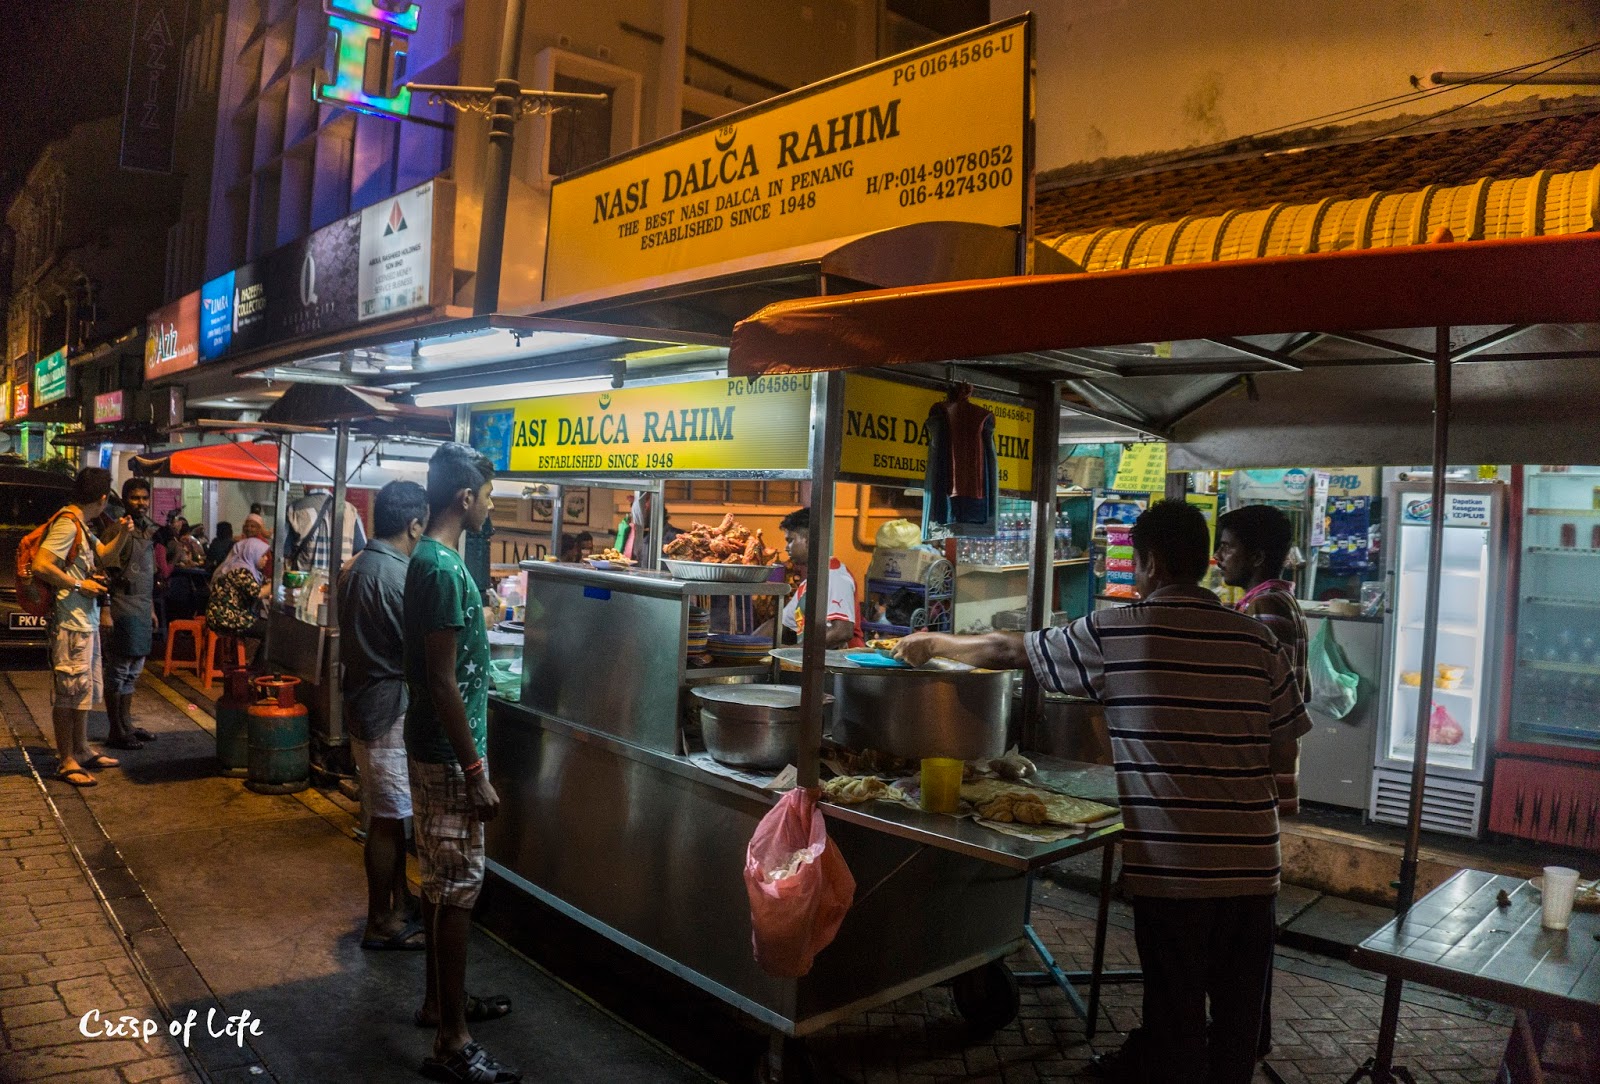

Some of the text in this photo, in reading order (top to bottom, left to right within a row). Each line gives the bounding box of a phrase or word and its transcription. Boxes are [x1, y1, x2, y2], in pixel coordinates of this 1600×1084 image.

[892, 34, 1014, 87] PG 0164586-U
[718, 125, 734, 137] 786
[592, 99, 901, 226] NASI DALCA RAHIM
[617, 160, 854, 239] THE BEST NASI DALCA IN PENANG
[899, 167, 1013, 208] 016-4274300
[640, 193, 817, 252] ESTABLISHED SINCE 1948
[727, 375, 812, 396] PG 0164586-U
[557, 413, 630, 446] DALCA
[643, 406, 736, 443] RAHIM
[846, 409, 897, 442] NASI
[996, 434, 1030, 460] HIM
[538, 453, 674, 469] ESTABLISHED SINCE 1948
[873, 453, 928, 473] ESTABLIS
[1106, 558, 1132, 567] PREMIER
[1107, 571, 1133, 580] PREMIER
[18, 615, 47, 627] PKV 6
